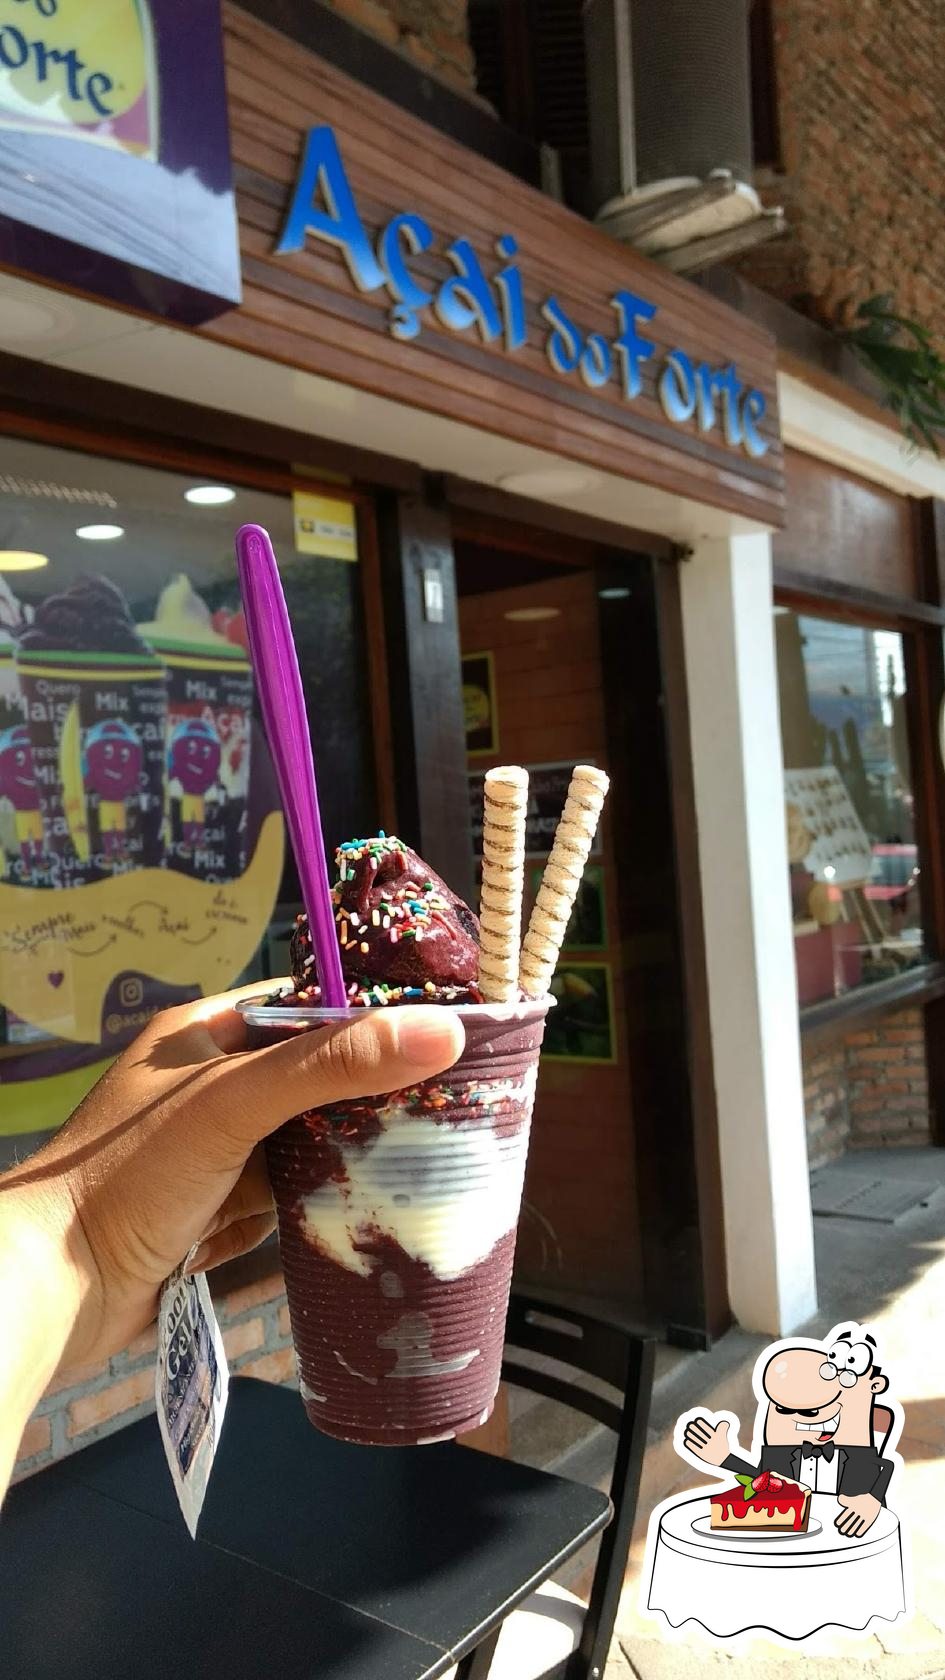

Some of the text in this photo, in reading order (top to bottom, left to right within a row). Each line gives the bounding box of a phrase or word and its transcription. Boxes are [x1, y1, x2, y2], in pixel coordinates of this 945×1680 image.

[542, 296, 613, 387] do
[611, 289, 770, 457] Forte
[95, 691, 129, 712] Mix
[187, 680, 218, 702] Mix
[194, 849, 226, 869] Mix
[166, 1320, 192, 1381] Gel
